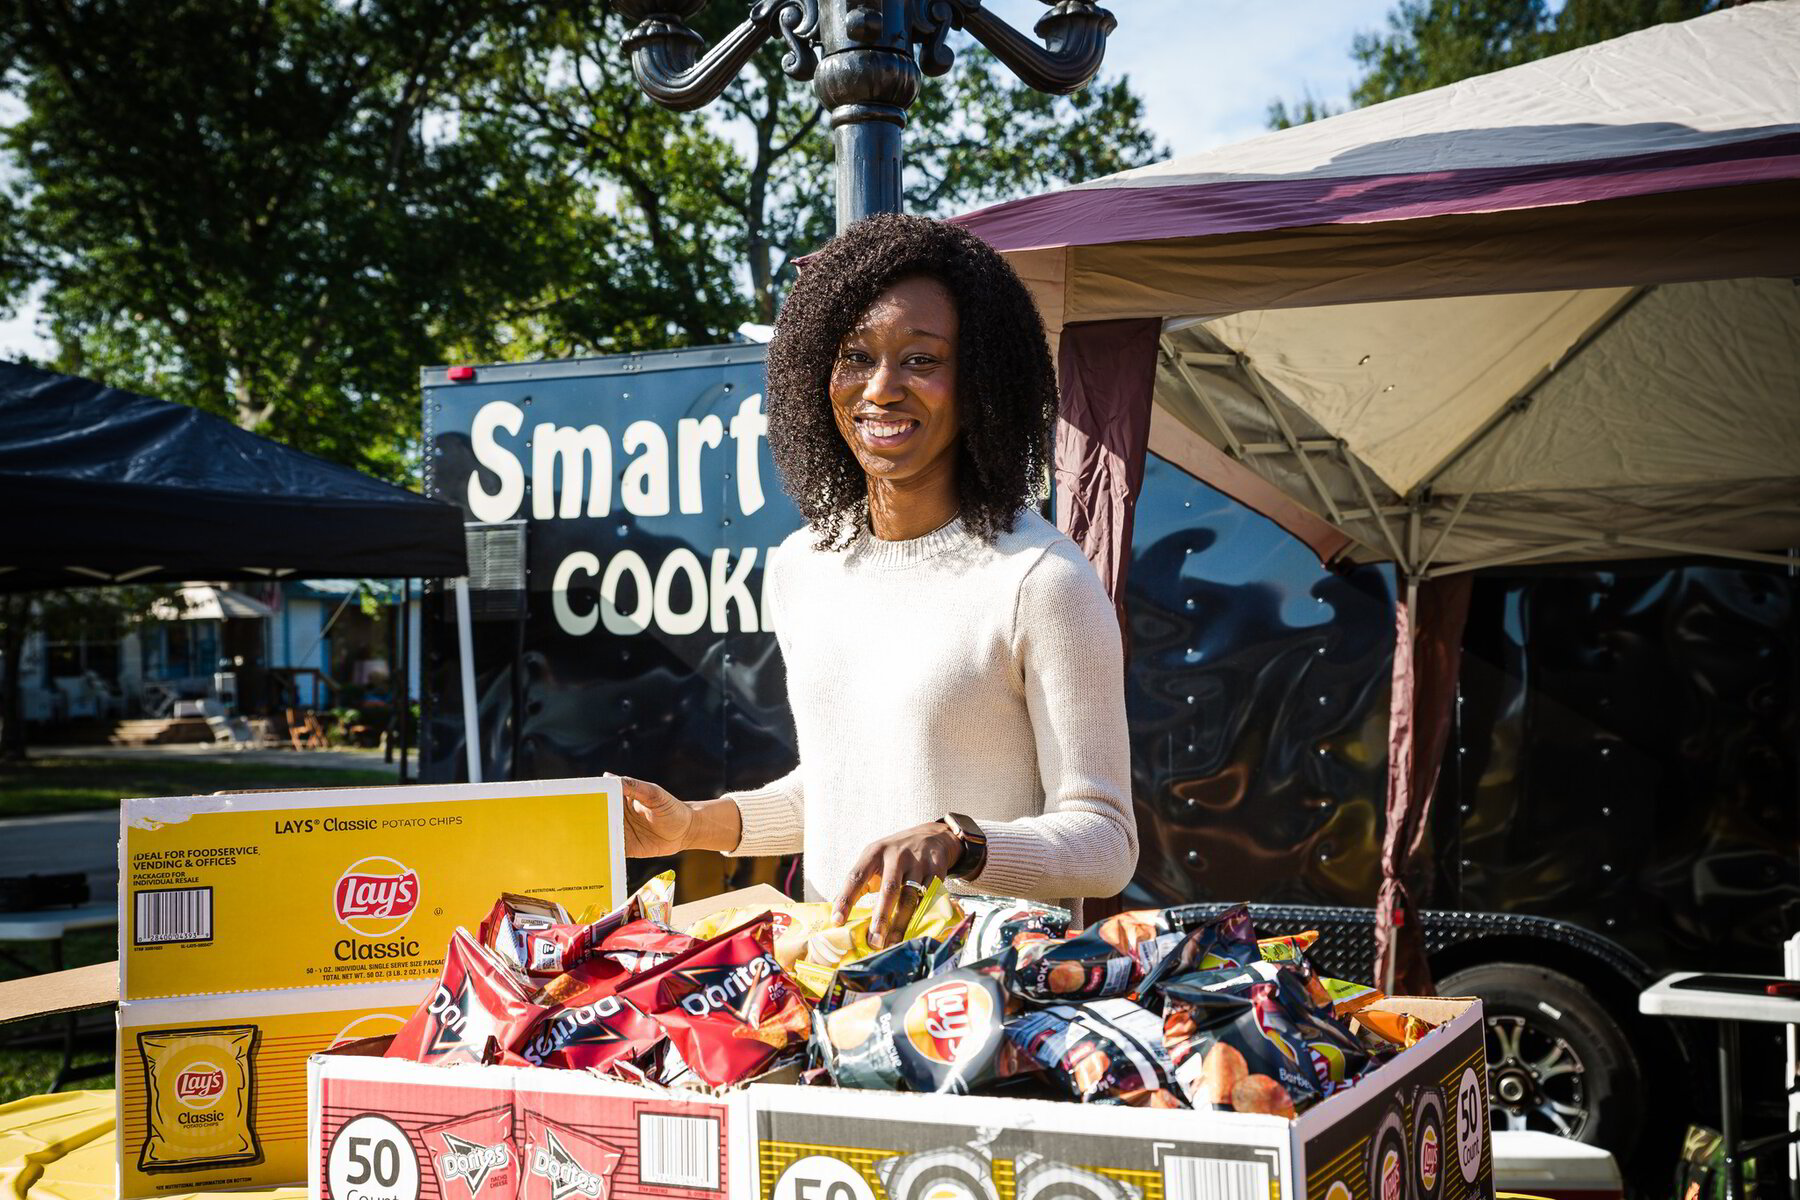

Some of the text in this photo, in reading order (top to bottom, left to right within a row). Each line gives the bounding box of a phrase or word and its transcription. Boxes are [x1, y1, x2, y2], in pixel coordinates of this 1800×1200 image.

[467, 393, 769, 524] Smart
[323, 817, 377, 832] Classic
[382, 818, 426, 829] POTATO
[429, 816, 463, 826] CHIPS
[133, 857, 237, 870] VENDING & OFFICES
[134, 852, 162, 861] IDEAL
[164, 850, 185, 859] FOR
[133, 872, 171, 880] PACKAGED
[342, 875, 413, 918] Lay's
[334, 936, 420, 961] Classic
[335, 964, 368, 972] INDIVIDUAL
[681, 953, 780, 1018] Doritos
[524, 995, 620, 1066] Doritos
[180, 1072, 221, 1097] Lay's
[178, 1110, 224, 1124] Classic
[1461, 1084, 1477, 1142] 50
[346, 1136, 400, 1187] 50
[442, 1145, 508, 1178] Doritos
[1463, 1137, 1480, 1167] Count
[532, 1148, 601, 1195] Doritos
